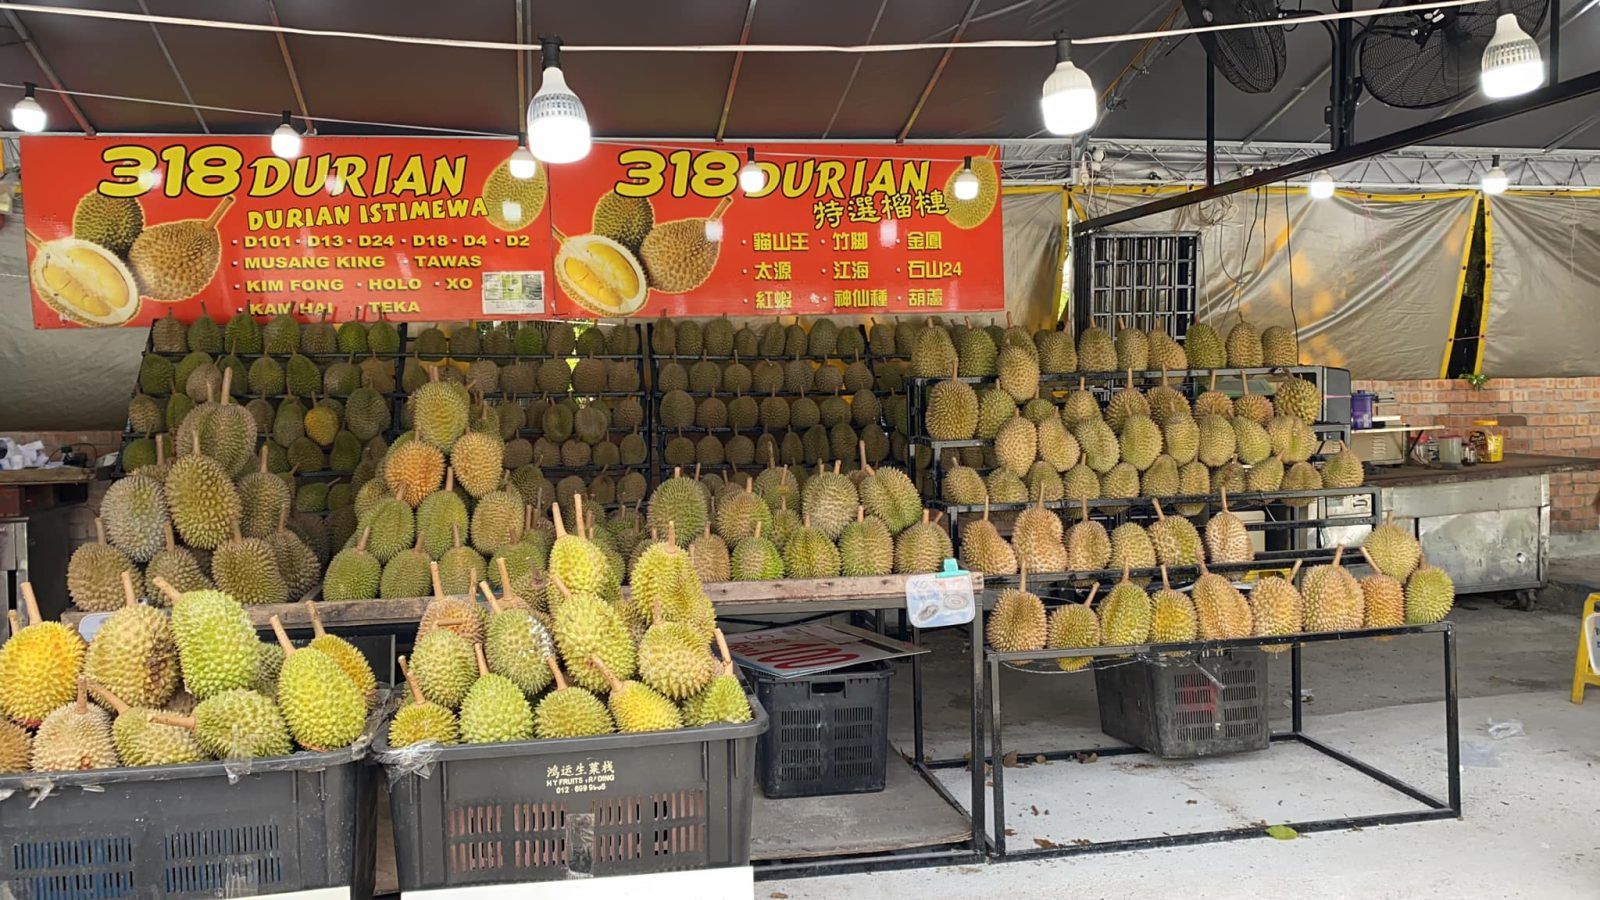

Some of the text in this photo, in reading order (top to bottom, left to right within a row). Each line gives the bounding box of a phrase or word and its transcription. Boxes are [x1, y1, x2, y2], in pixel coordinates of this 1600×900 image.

[97, 144, 468, 198] 318 DURIAN
[614, 147, 741, 198] 318
[247, 197, 489, 232] DURIAN ISTIMEWA
[244, 234, 530, 248] D101 D13 D24 D18 D4 D2
[753, 232, 810, 251] 貓山王
[244, 254, 482, 270] MUSANG KING TAWAS
[754, 261, 792, 280] 太源
[833, 260, 869, 279] 江海
[907, 260, 962, 279] 石山24
[246, 279, 284, 293] KIM
[290, 279, 344, 292] FONG
[368, 278, 422, 291] HOLO
[446, 278, 473, 290] XO
[300, 302, 334, 314] HAI
[368, 301, 421, 313] TEKA
[558, 777, 583, 786] FRUITS
